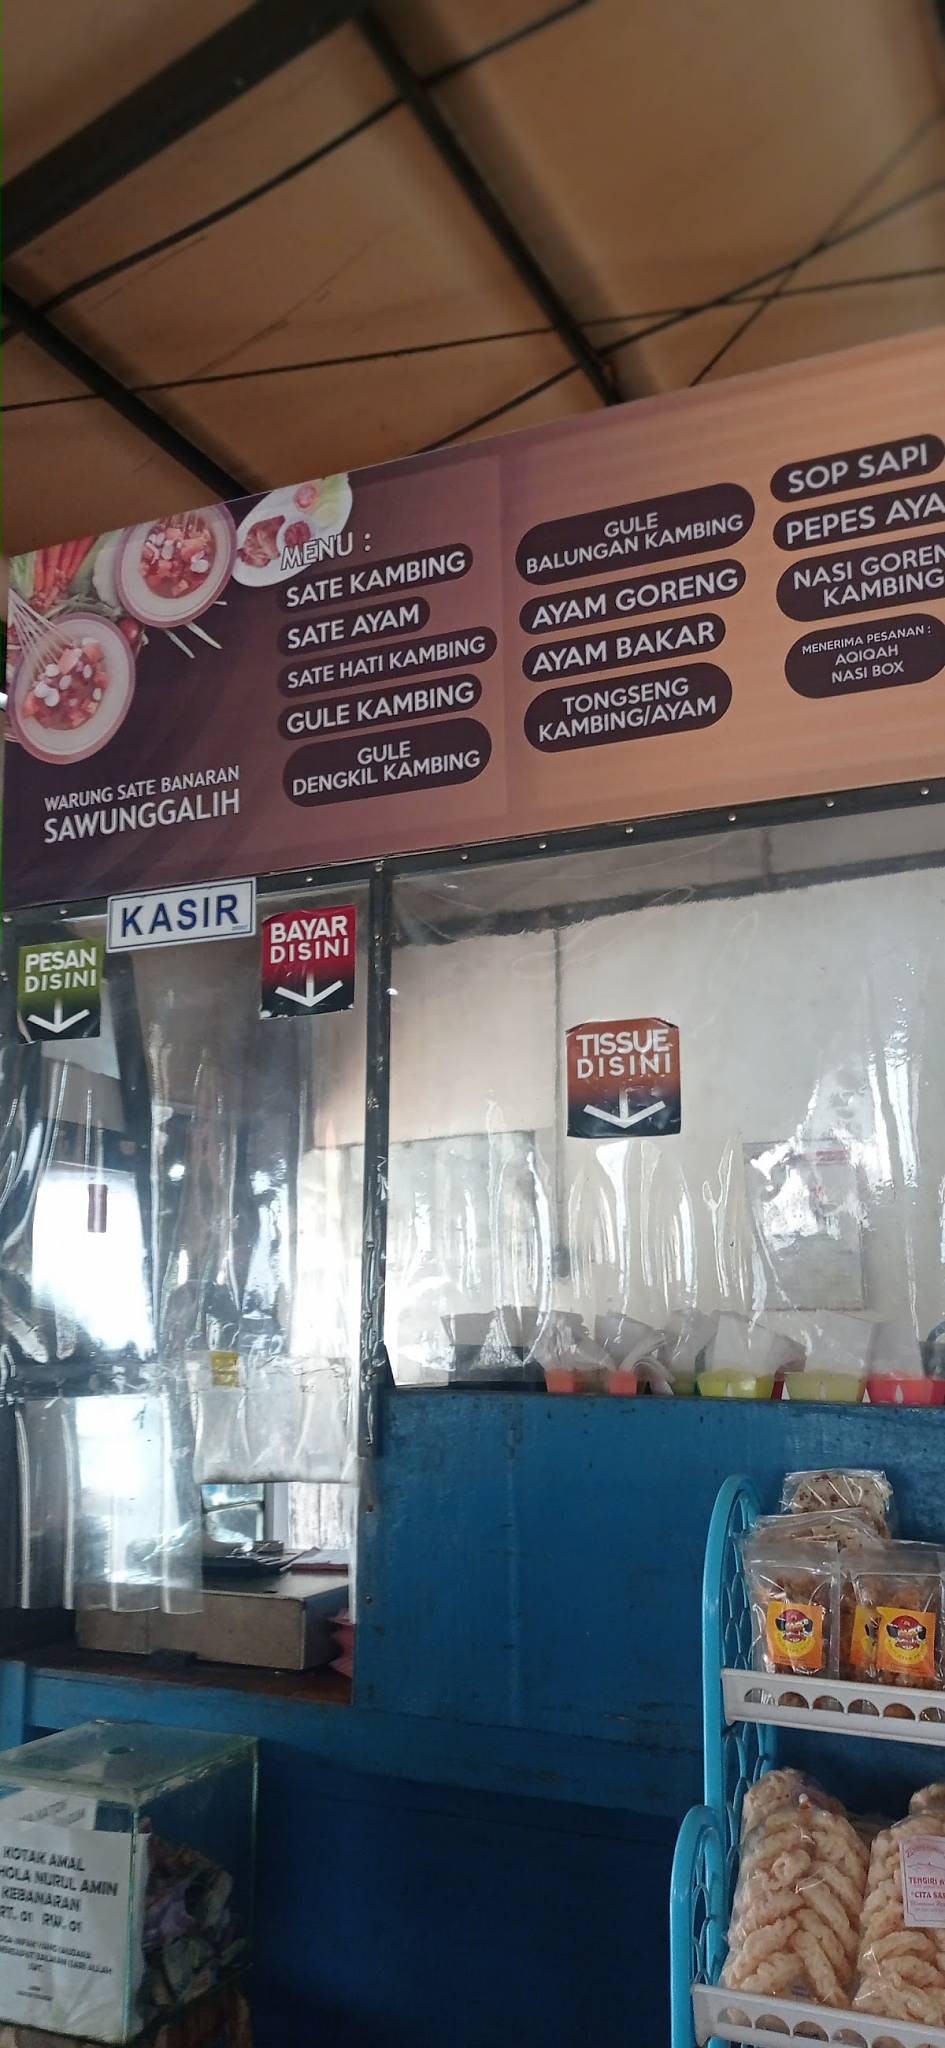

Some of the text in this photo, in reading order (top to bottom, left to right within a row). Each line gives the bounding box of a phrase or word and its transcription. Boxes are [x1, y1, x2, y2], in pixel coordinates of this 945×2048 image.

[788, 443, 928, 494] SOP SAPI
[526, 514, 743, 574] BALUNGAN KAMBING
[604, 512, 658, 538] GULE
[786, 505, 876, 545] PEPES
[281, 532, 353, 570] MENU
[286, 551, 466, 608] SATE KAMBING
[793, 561, 852, 590] NASI
[824, 568, 945, 607] KAMBING
[531, 568, 738, 629] AYAM GORENG
[287, 604, 420, 650] SATE AYAM
[802, 636, 864, 655] MENERIMA
[867, 625, 924, 644] PESANAN
[287, 636, 486, 689] SATE HATI KAMBING
[531, 621, 716, 675] AYAM BAKAR
[835, 644, 899, 666] AQIQAH
[832, 661, 904, 683] NASI BOX
[287, 682, 474, 733] GULE KAMBING
[562, 677, 689, 716] TONGSENG
[539, 695, 716, 742] KAMBING/AYAM
[357, 740, 411, 765] GULE
[44, 765, 239, 812] WARUNG SATE BANARAN
[293, 750, 480, 796] DENGKIL KAMBING
[44, 788, 240, 844] SAWUNGGALIH
[121, 894, 239, 937] KASIR
[270, 915, 348, 944] BAYAR
[25, 948, 96, 973] PESAN
[270, 938, 349, 964] DISINI
[24, 969, 96, 993] DISINI
[576, 1028, 670, 1056] TISSUE
[577, 1053, 671, 1079] DISINI
[3, 1846, 85, 1871] KOTAK AMAL
[1, 1886, 81, 1912] KEBANARAN
[34, 1871, 77, 1891] NURUL
[80, 1879, 119, 1896] AMIN
